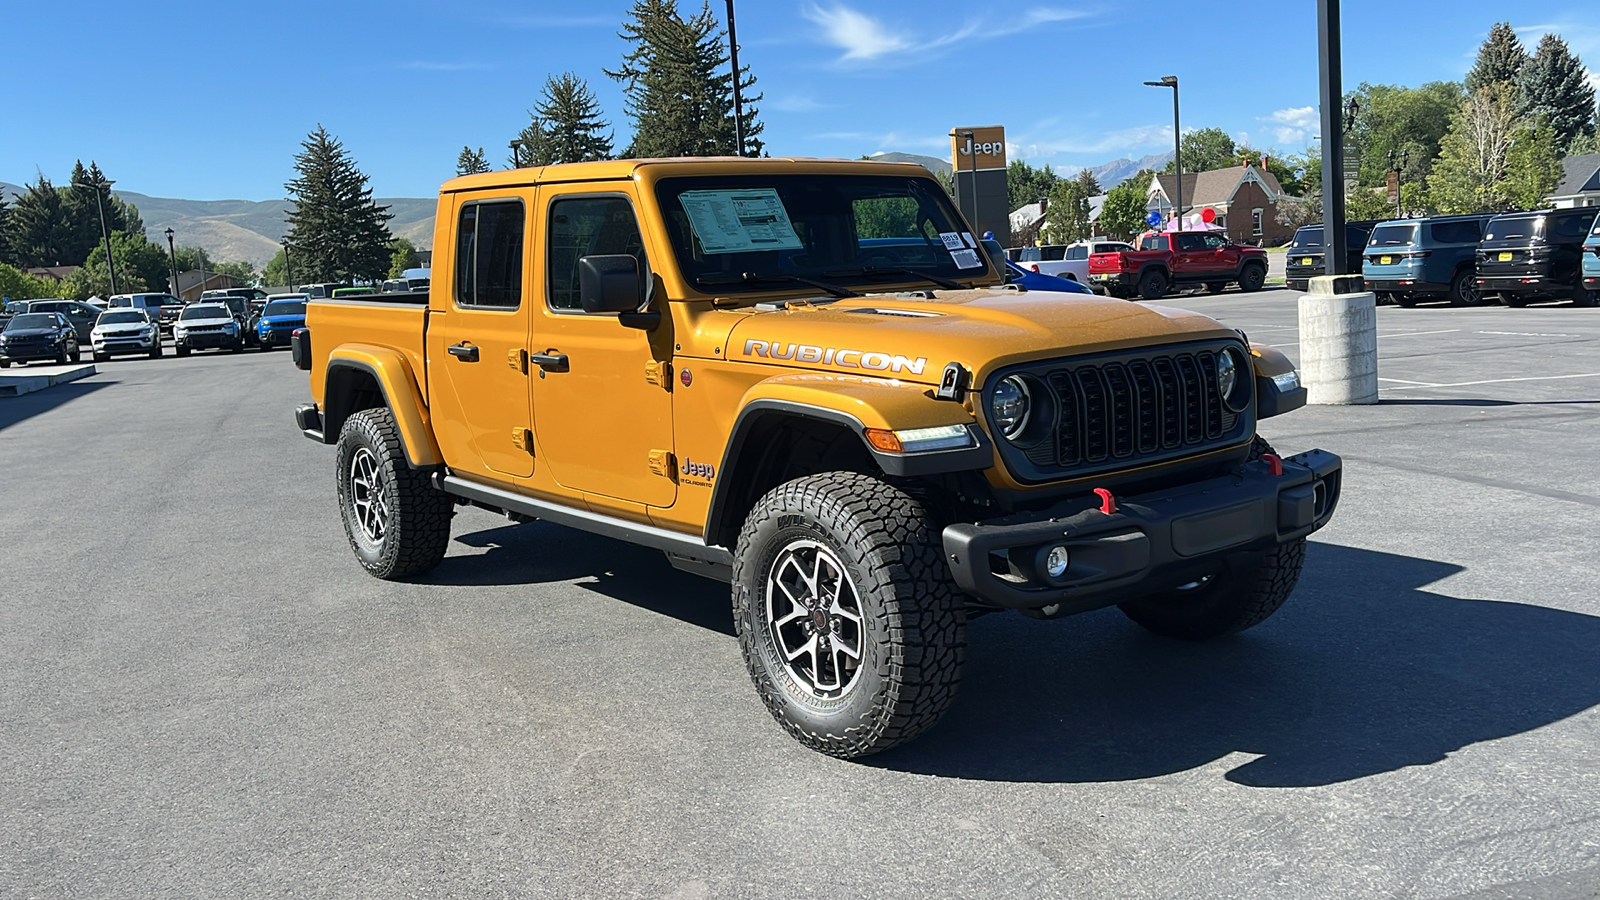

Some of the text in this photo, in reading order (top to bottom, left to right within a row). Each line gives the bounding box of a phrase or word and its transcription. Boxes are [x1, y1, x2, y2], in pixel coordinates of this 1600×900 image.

[959, 139, 1002, 157] Jeep
[743, 338, 928, 376] RUBICON
[680, 456, 715, 482] Jeep
